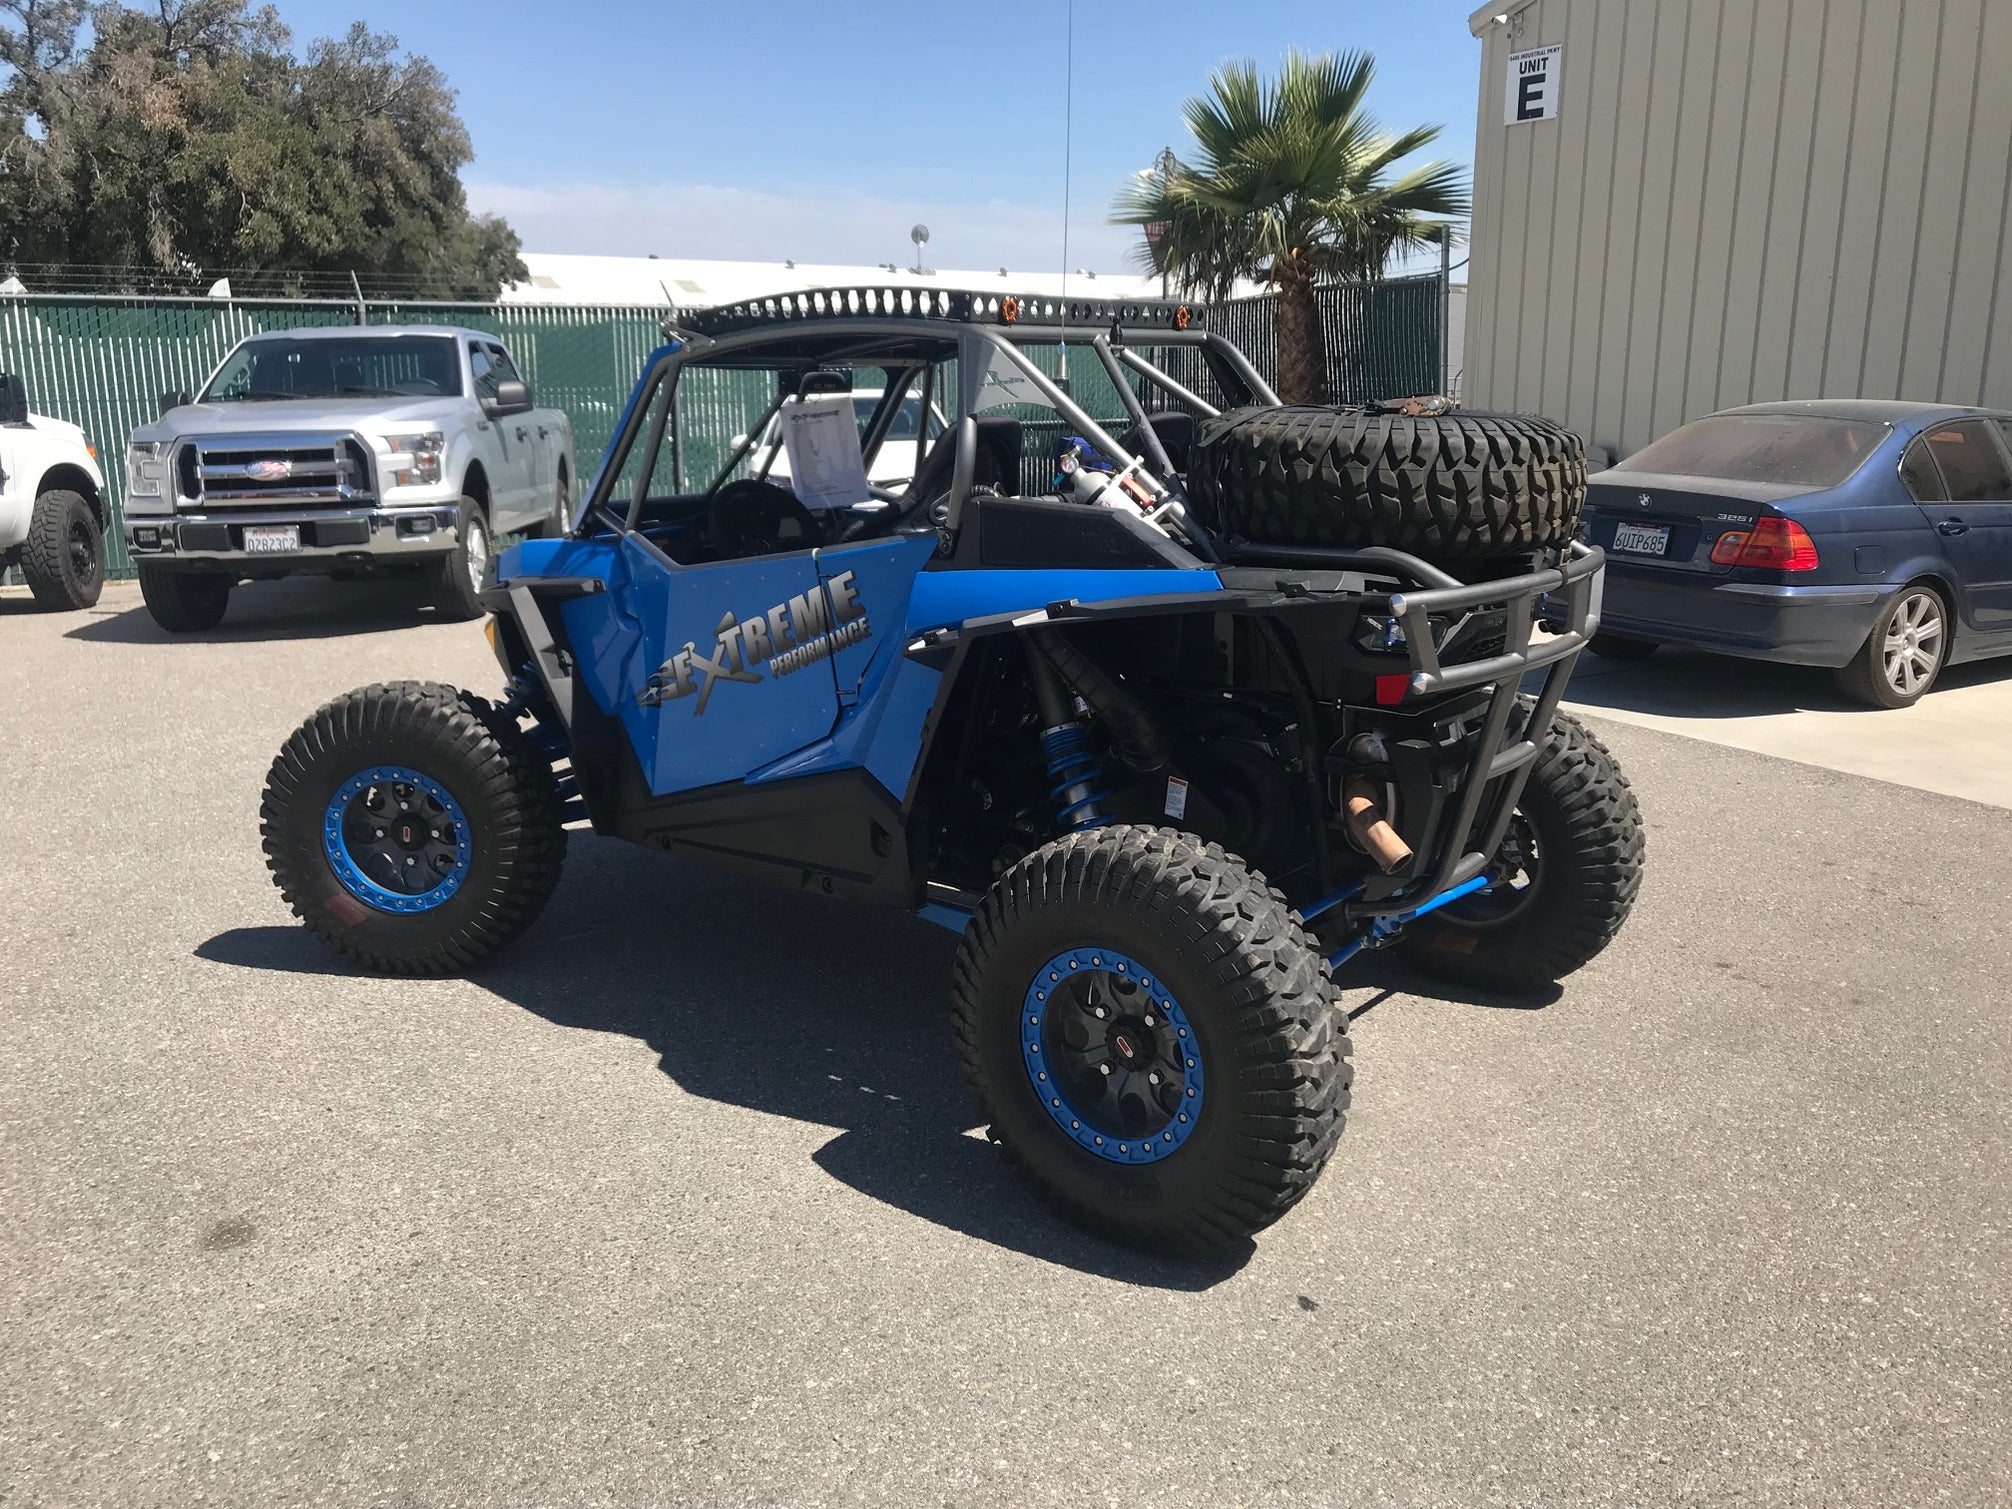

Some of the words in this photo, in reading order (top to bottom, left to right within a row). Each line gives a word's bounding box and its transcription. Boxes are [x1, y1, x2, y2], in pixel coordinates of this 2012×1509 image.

[1519, 57, 1549, 75] UNIT
[1517, 73, 1546, 121] E
[1615, 532, 1666, 552] 6UIP685
[636, 569, 867, 717] EXTREME
[769, 616, 873, 679] PERFORMANCE
